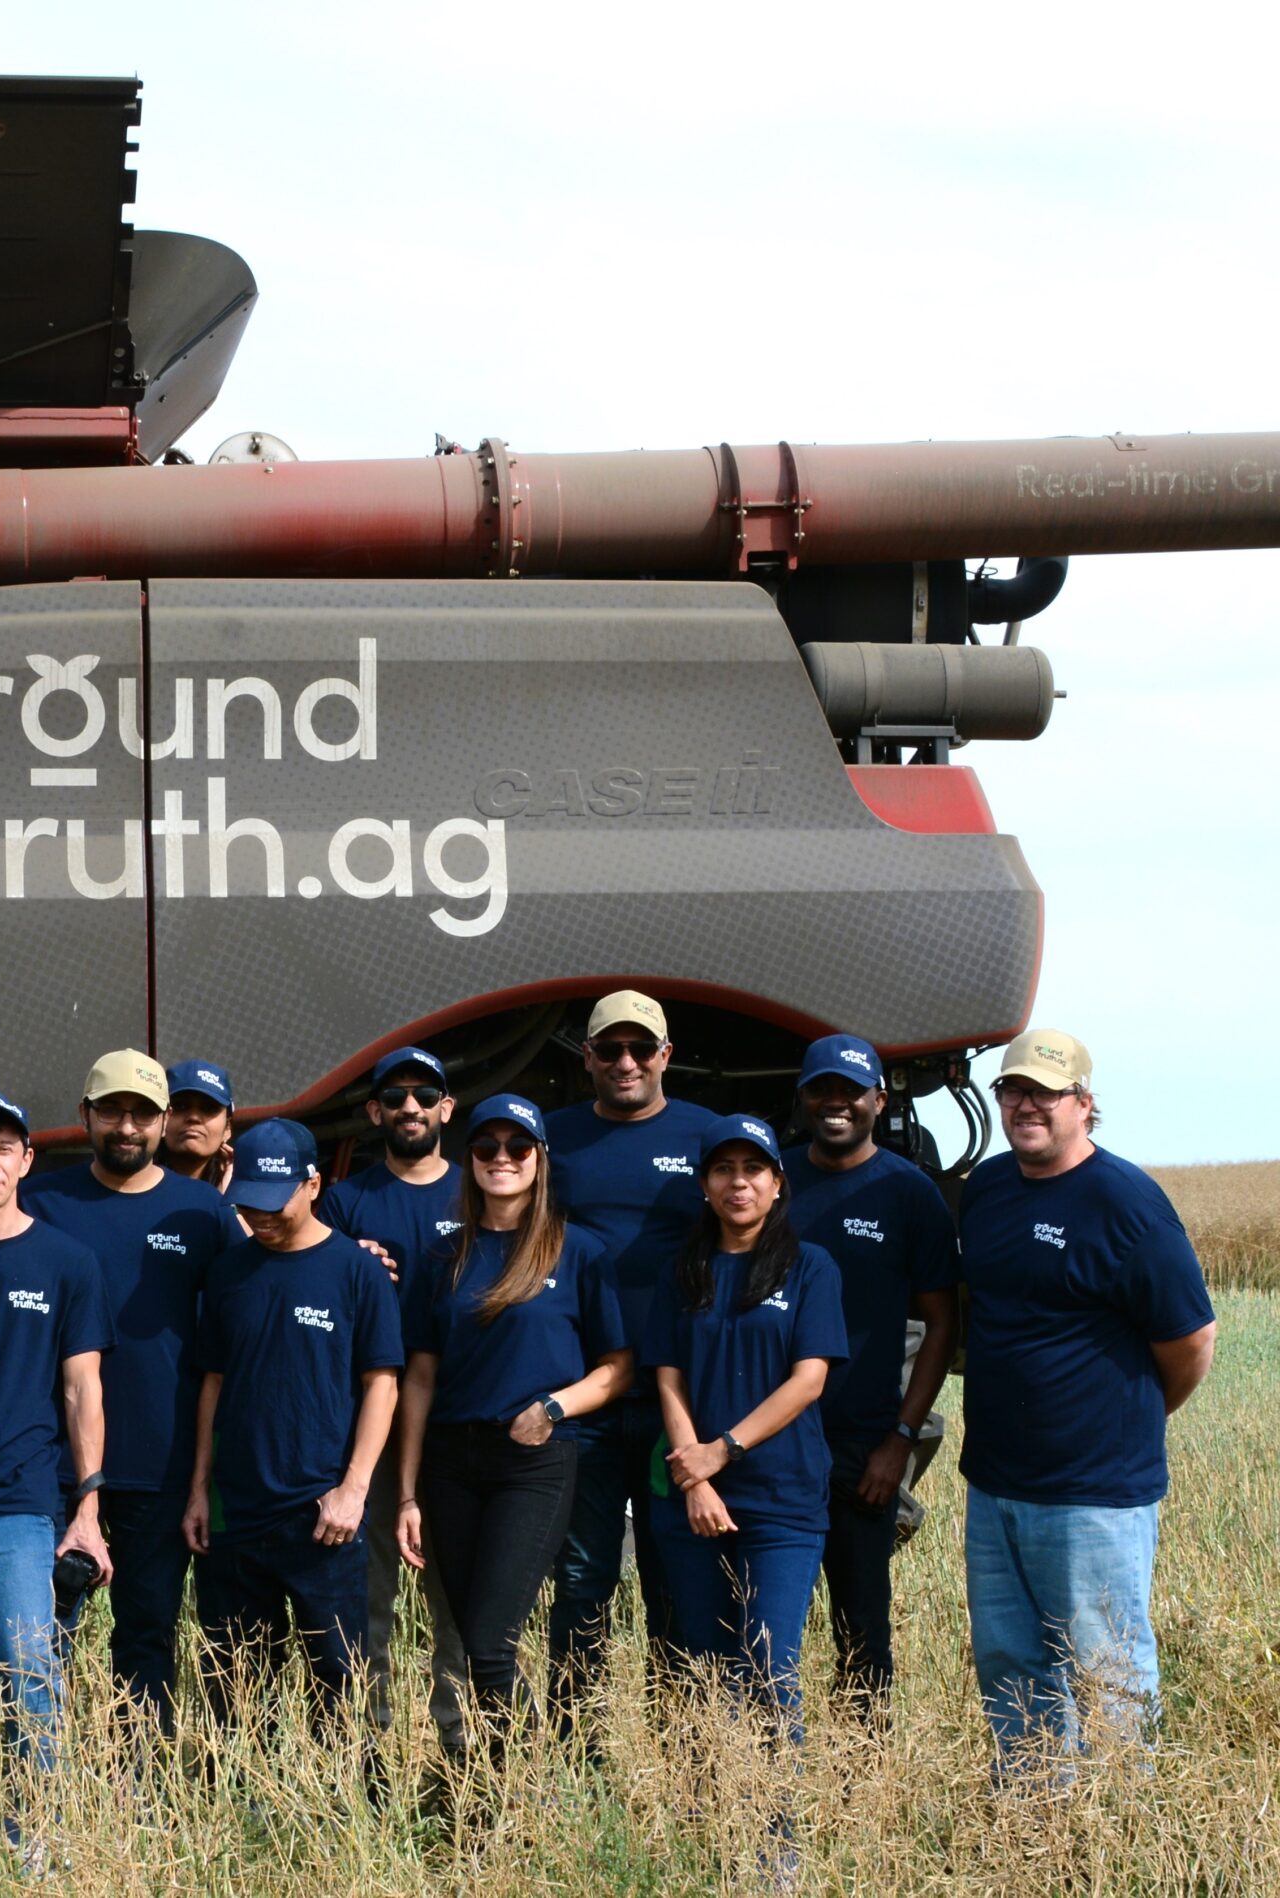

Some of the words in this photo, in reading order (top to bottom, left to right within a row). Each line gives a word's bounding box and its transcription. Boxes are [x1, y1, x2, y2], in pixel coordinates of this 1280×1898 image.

[1016, 461, 1217, 498] Real-time
[473, 768, 701, 818] CASE
[257, 1157, 286, 1167] ground
[652, 1156, 686, 1166] ground
[262, 1165, 292, 1175] truth.ag
[658, 1164, 694, 1176] truth.ag
[843, 1218, 878, 1230] ground
[1033, 1223, 1064, 1236] ground
[147, 1233, 180, 1244] ground
[847, 1227, 884, 1242] truth.ag
[1034, 1232, 1066, 1249] truth.ag
[152, 1241, 186, 1255] truth.ag
[8, 1290, 44, 1302] ground
[13, 1299, 50, 1314] truth.ag
[294, 1306, 329, 1319] ground
[297, 1315, 334, 1332] truth.ag
